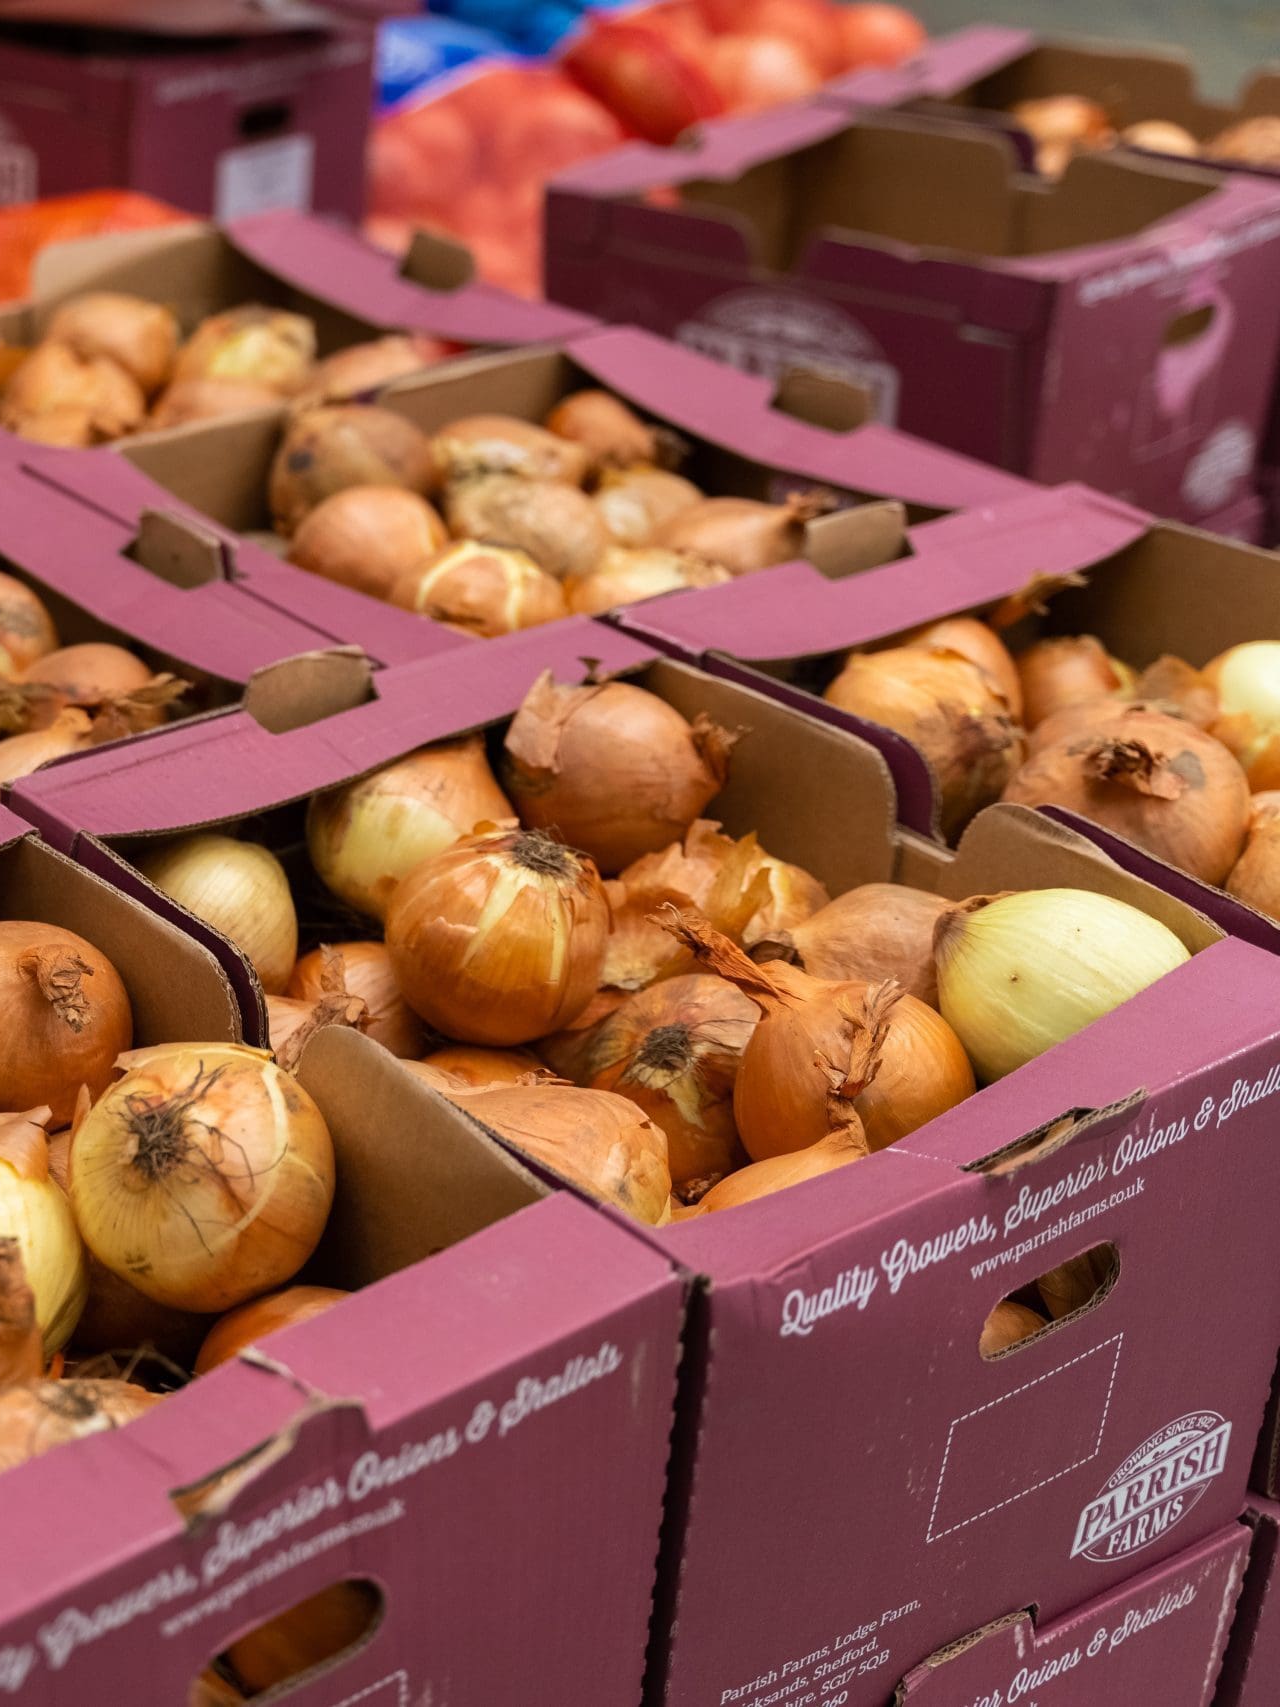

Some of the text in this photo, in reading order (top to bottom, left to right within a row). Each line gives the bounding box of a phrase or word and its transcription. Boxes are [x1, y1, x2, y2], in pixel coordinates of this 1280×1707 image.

[780, 1264, 879, 1337] Quality
[881, 1215, 998, 1295] Growers,
[1003, 1155, 1109, 1238] Superior
[1112, 1116, 1189, 1176] Onions
[1194, 1096, 1216, 1131] &
[970, 1176, 1146, 1280] www.parrishfarms.co.uk
[201, 1476, 344, 1586] Superior
[346, 1425, 461, 1501] Onions
[464, 1400, 498, 1443] &
[498, 1341, 623, 1437] Shallots
[1078, 1431, 1228, 1546] PARRISH
[1108, 1432, 1164, 1489] GROWING
[1164, 1416, 1198, 1440] SINCE
[1106, 1495, 1184, 1556] FARMS
[720, 1670, 778, 1706] Parrish
[781, 1646, 831, 1679] Farms,
[834, 1620, 878, 1651] Lodge
[813, 1637, 879, 1681] Shefford,
[820, 1668, 857, 1696] SG17
[858, 1650, 891, 1676] 5QB
[1008, 1650, 1083, 1703] Onions
[1086, 1627, 1109, 1657] &
[1109, 1583, 1198, 1653] Shallots
